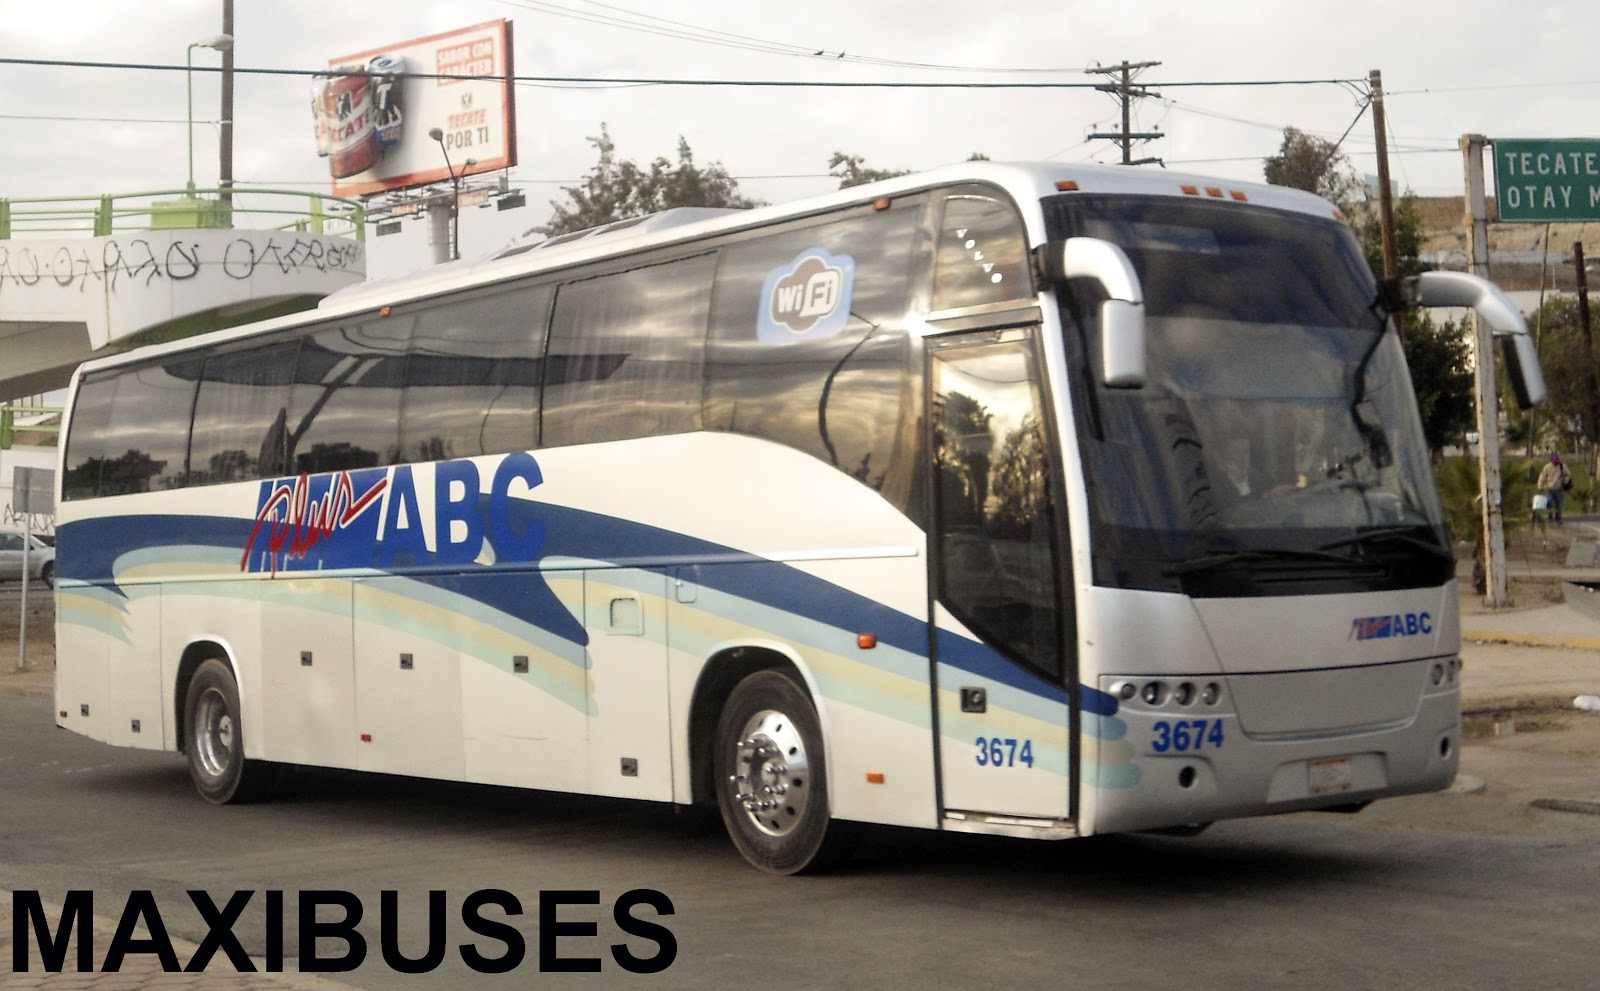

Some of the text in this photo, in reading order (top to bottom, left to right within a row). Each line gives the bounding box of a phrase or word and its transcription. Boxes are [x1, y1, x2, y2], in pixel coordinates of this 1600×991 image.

[447, 126, 488, 150] POR TI
[1505, 152, 1599, 175] TECATE
[1507, 186, 1573, 208] OTAY
[955, 228, 1003, 284] VOLVO
[380, 450, 547, 567] ABC
[1393, 612, 1432, 637] ABC
[1152, 719, 1224, 753] 3674
[976, 737, 1034, 769] 3674
